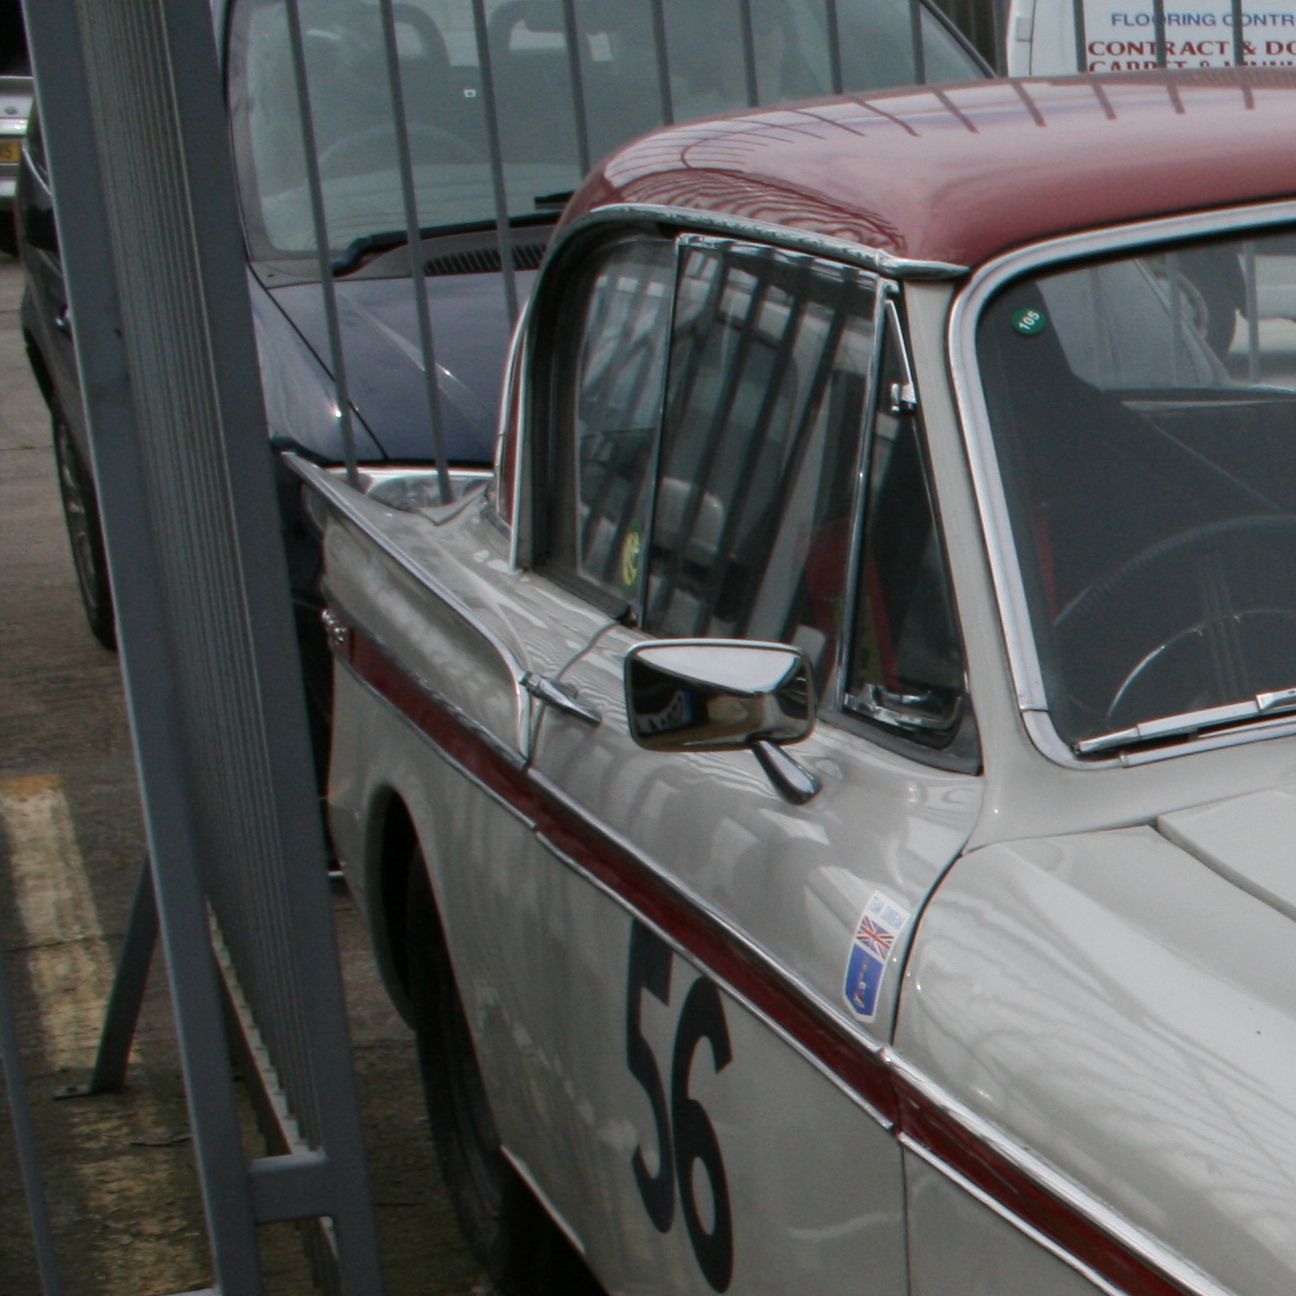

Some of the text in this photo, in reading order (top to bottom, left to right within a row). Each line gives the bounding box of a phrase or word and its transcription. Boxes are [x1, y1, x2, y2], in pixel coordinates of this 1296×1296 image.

[1088, 40, 1229, 56] CONTRACT
[1018, 309, 1040, 330] 105
[626, 917, 734, 1294] 56
